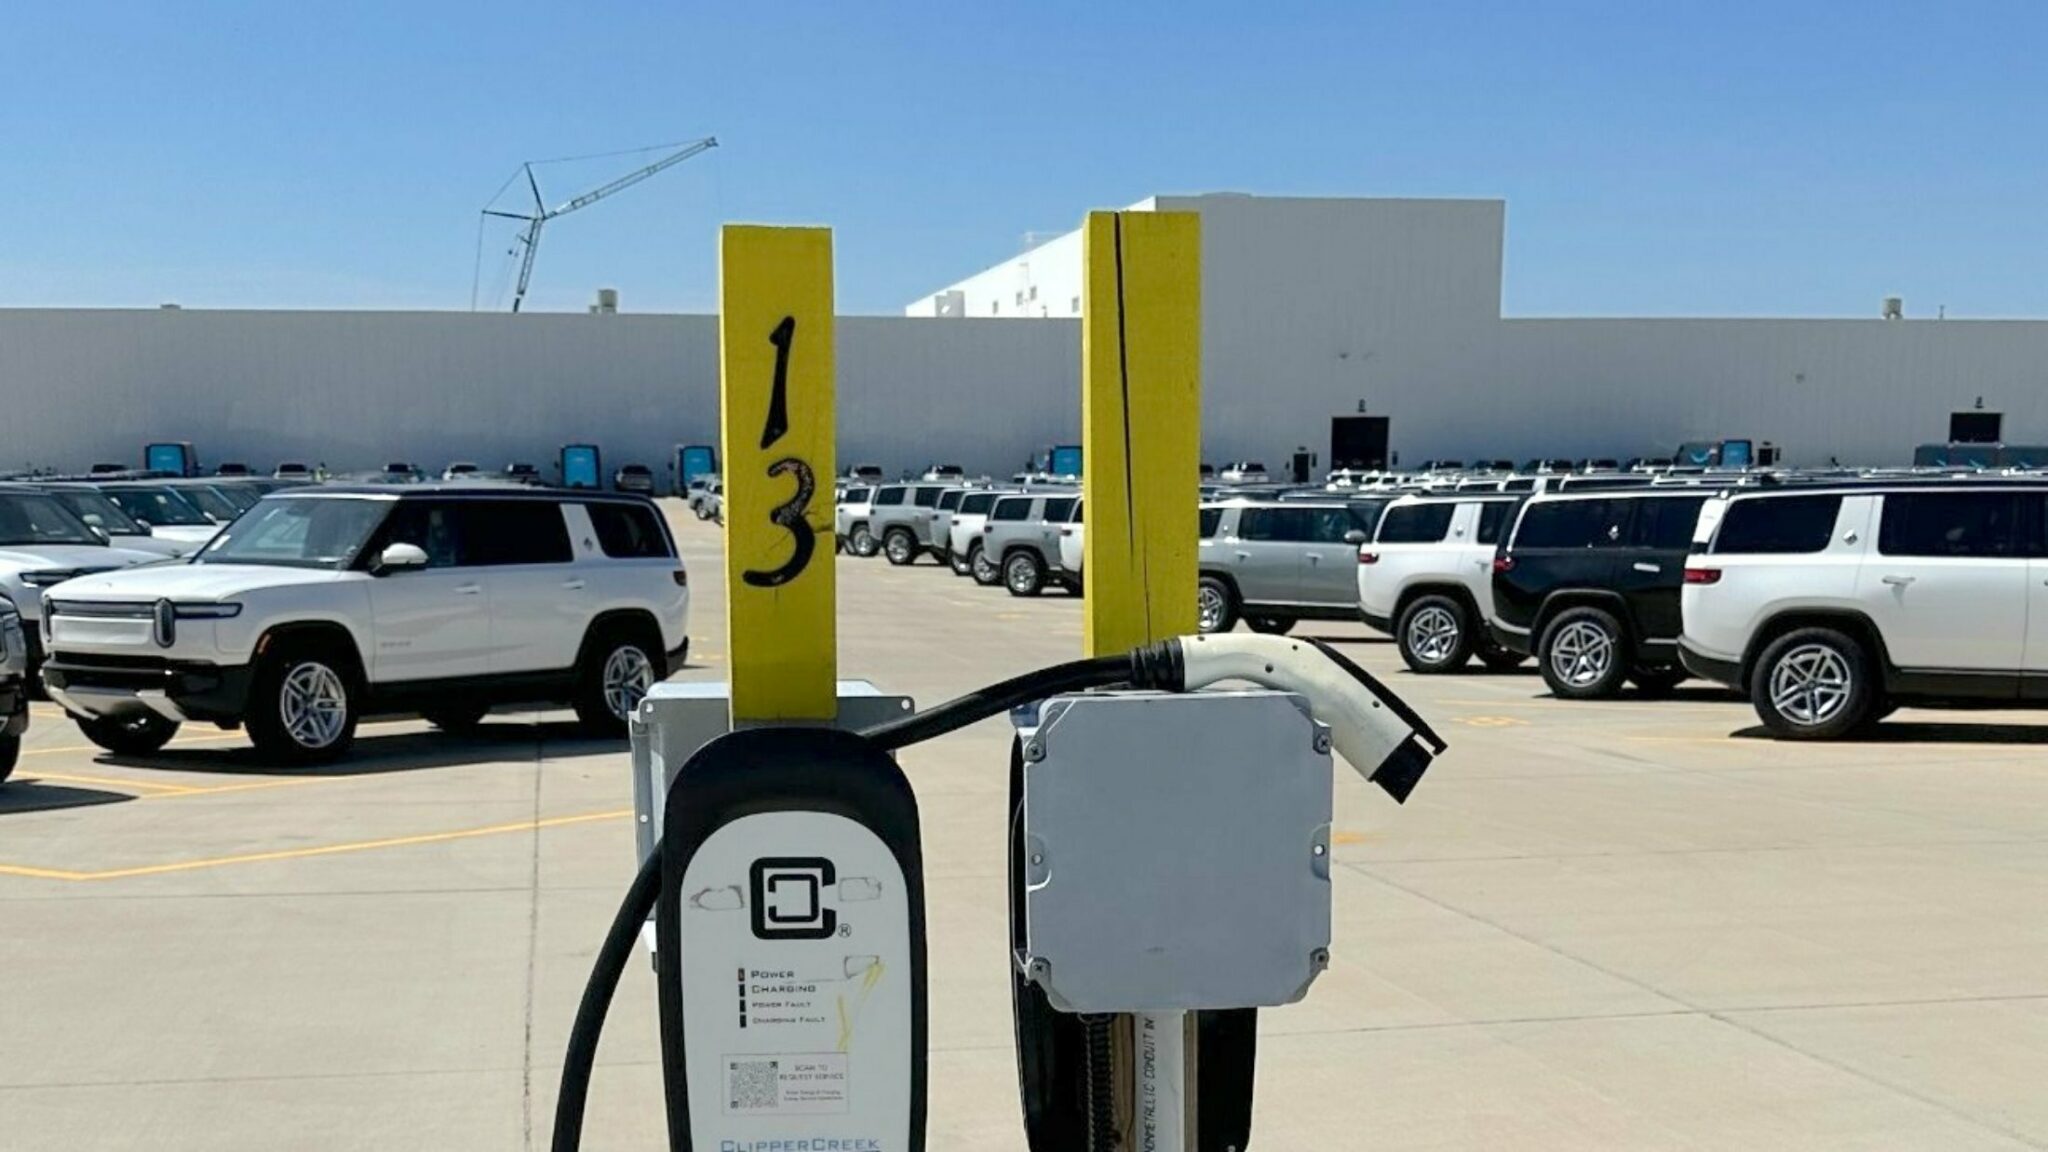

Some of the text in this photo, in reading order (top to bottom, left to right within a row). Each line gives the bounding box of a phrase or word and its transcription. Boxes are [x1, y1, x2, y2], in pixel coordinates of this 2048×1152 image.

[750, 970, 794, 979] POWER
[751, 984, 816, 993] CHARGING
[1143, 1033, 1156, 1080] CONDUIT
